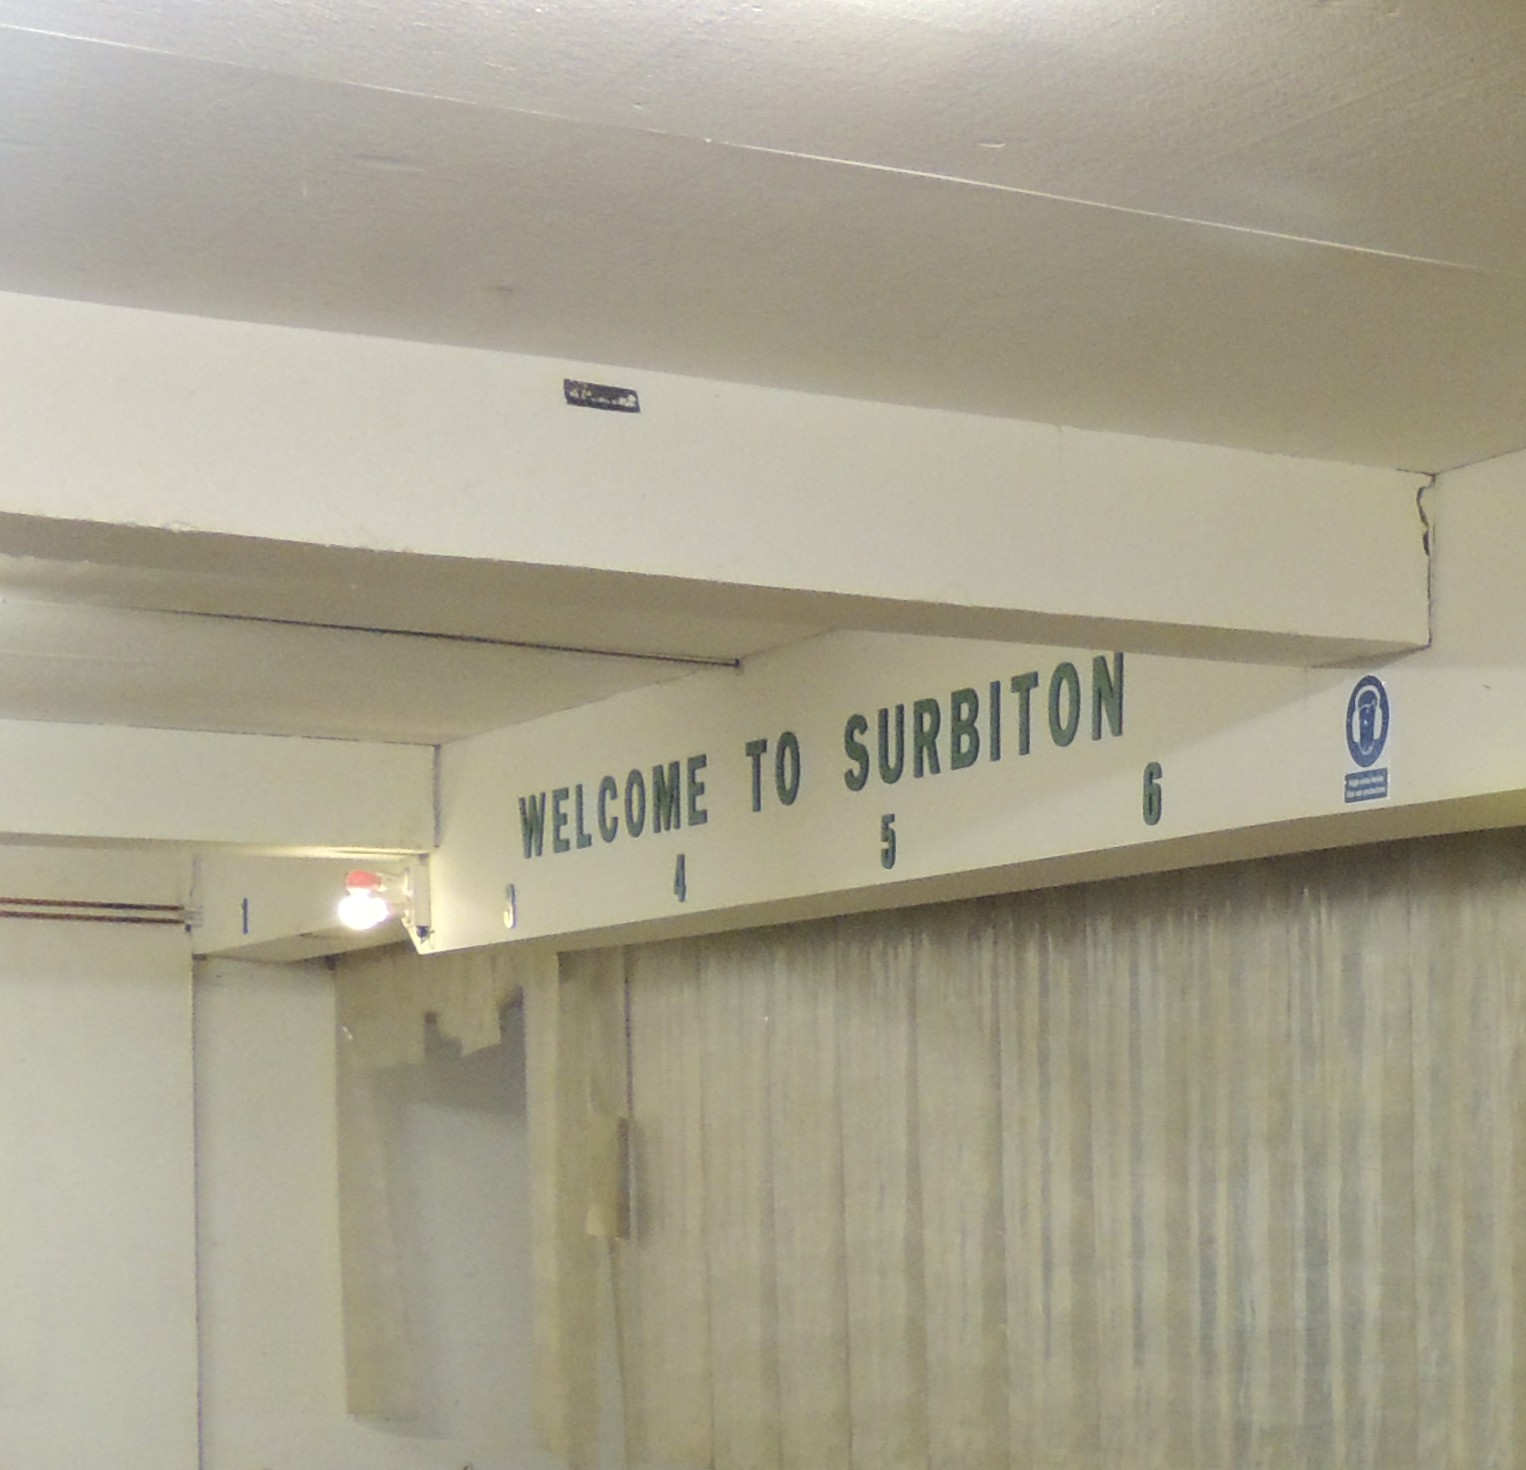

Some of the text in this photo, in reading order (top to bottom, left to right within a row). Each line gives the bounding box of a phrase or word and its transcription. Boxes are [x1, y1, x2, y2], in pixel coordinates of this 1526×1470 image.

[518, 754, 708, 859] WELCOME
[745, 731, 800, 812] TO
[844, 651, 1125, 791] SURBITON
[1142, 761, 1163, 826] 6
[880, 813, 897, 870] 5
[673, 853, 687, 903] 4
